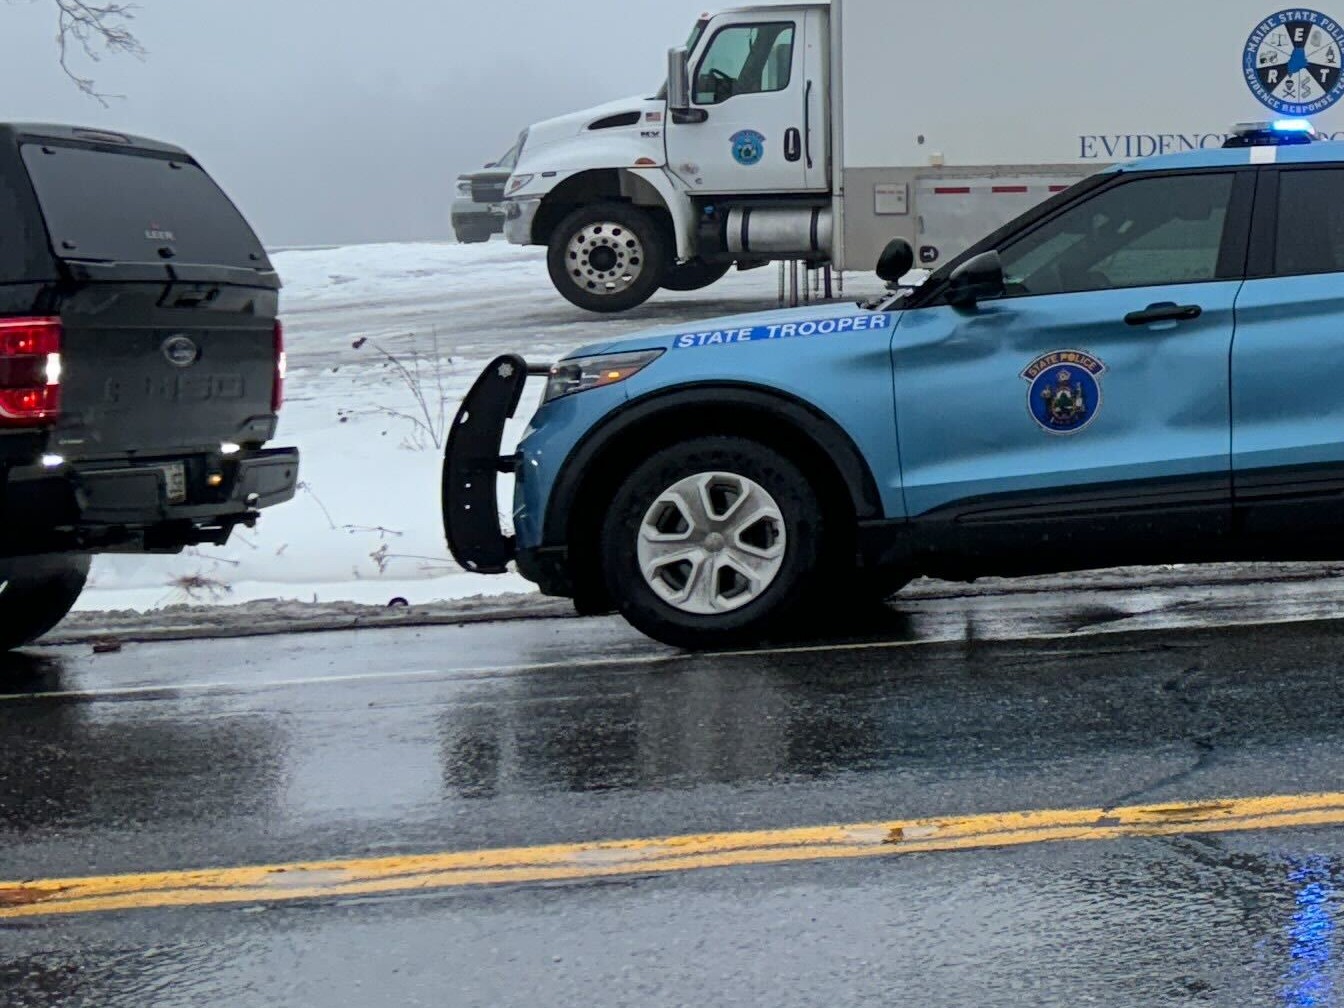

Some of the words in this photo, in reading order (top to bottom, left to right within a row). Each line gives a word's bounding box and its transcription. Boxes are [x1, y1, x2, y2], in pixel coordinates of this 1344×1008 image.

[1247, 18, 1277, 52] MAINE
[1279, 11, 1317, 23] STATE
[1294, 27, 1305, 42] E
[1245, 68, 1280, 109] EVIDENCE
[1267, 69, 1278, 84] R
[1320, 68, 1330, 83] T
[1079, 133, 1231, 158] EVIDENC
[677, 327, 754, 348] STATE
[767, 313, 886, 339] TROOPER
[1028, 355, 1058, 377] STATE
[1060, 353, 1098, 371] POLICE
